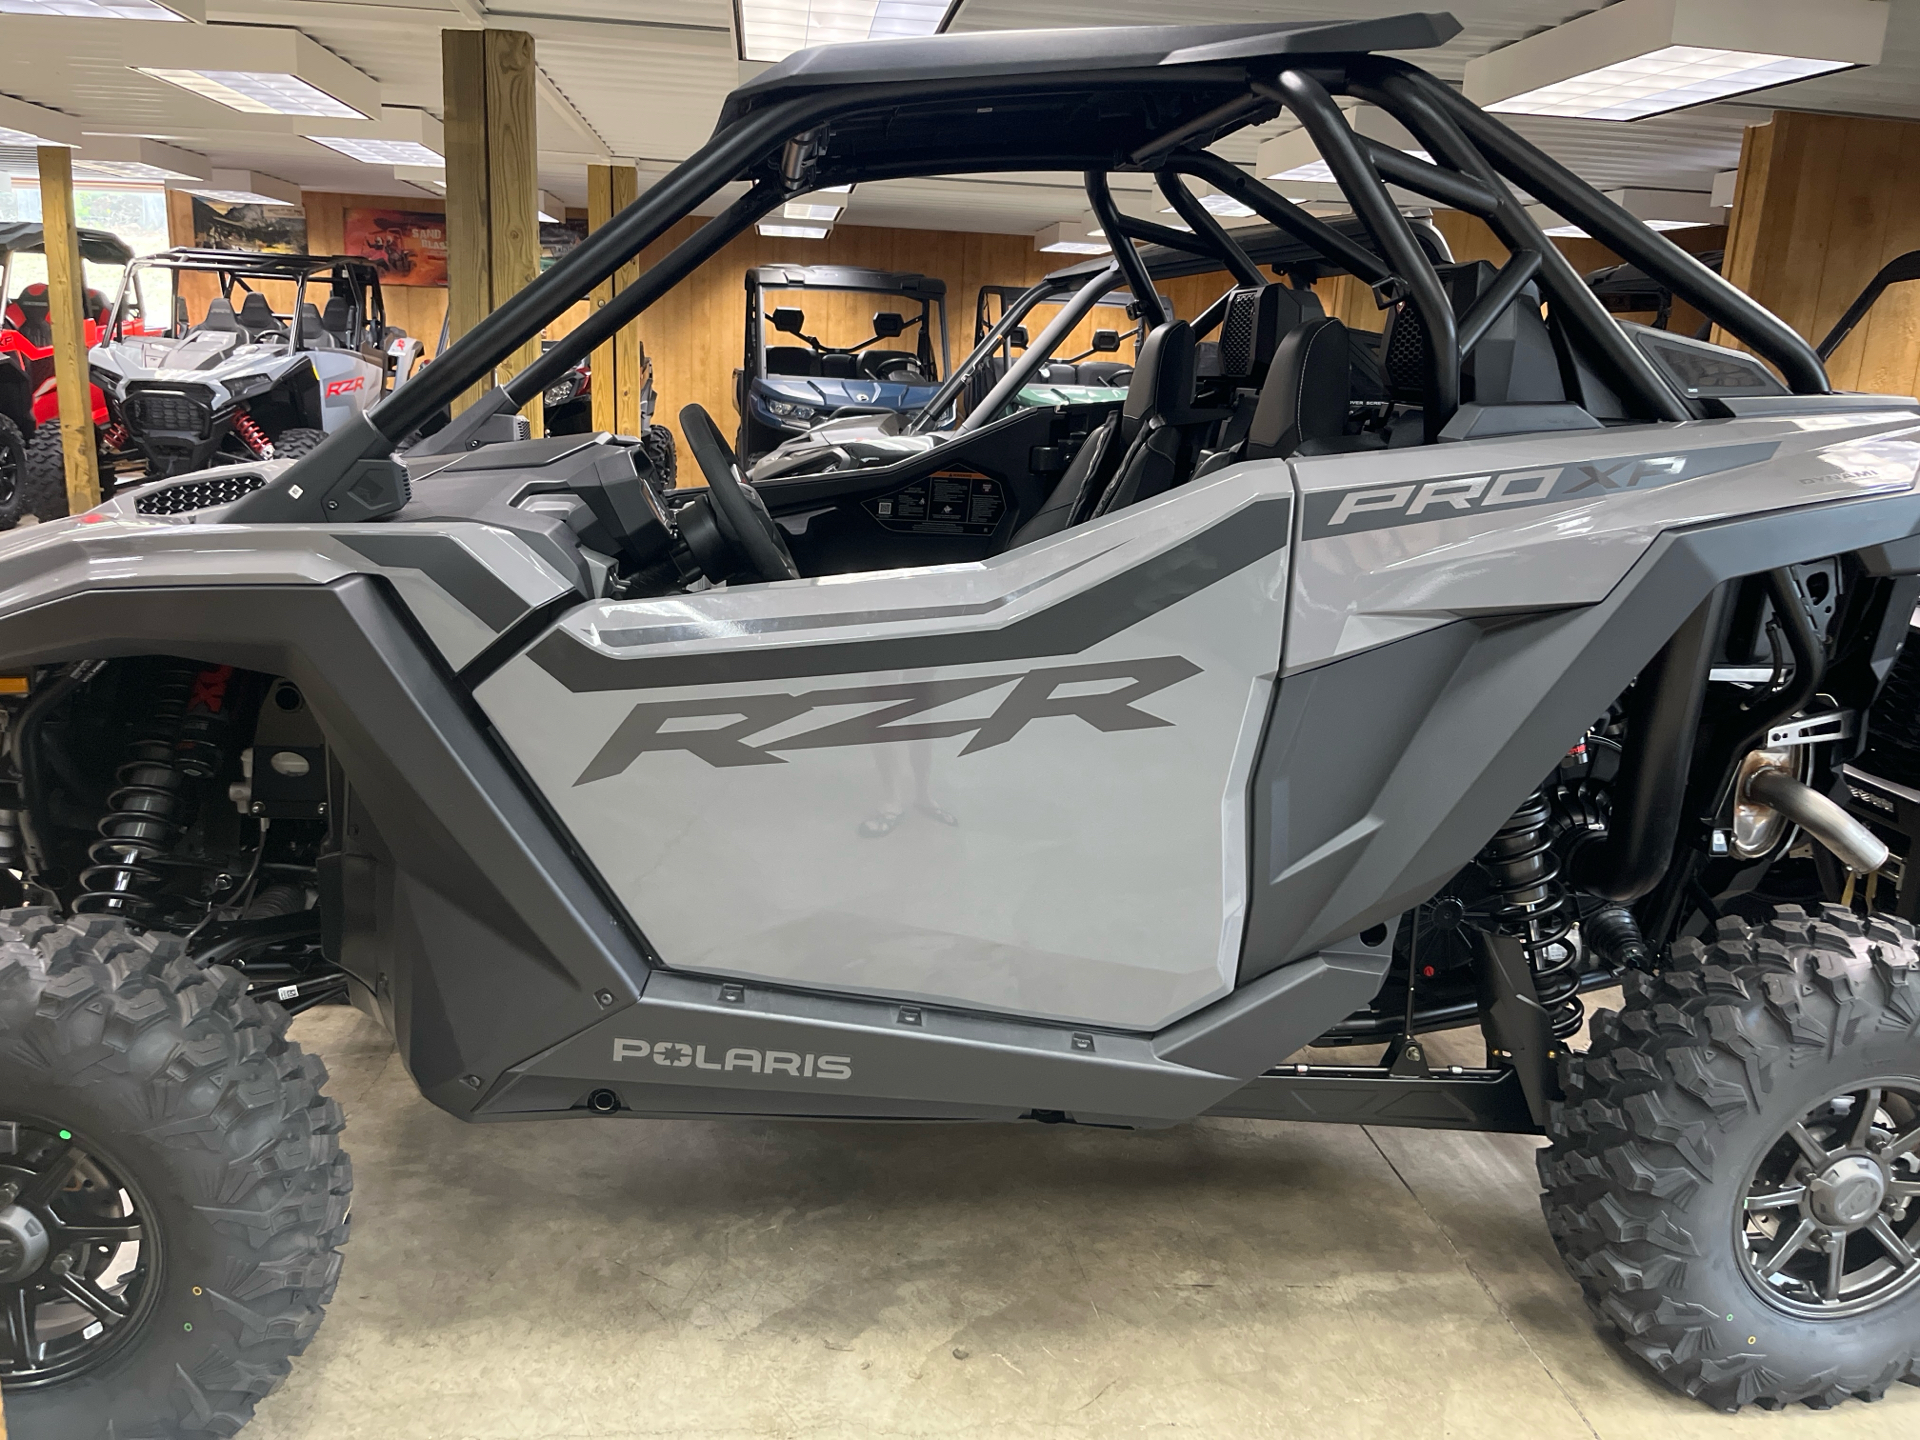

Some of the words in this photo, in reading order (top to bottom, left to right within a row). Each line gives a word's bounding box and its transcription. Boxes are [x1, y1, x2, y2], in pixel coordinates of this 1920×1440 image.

[412, 228, 441, 239] SAND
[421, 239, 448, 250] BLAS
[325, 376, 364, 399] RZR
[1327, 467, 1565, 526] PRO
[1563, 455, 1688, 494] XP
[572, 655, 1206, 788] RZR
[613, 1037, 852, 1080] POLARIS
